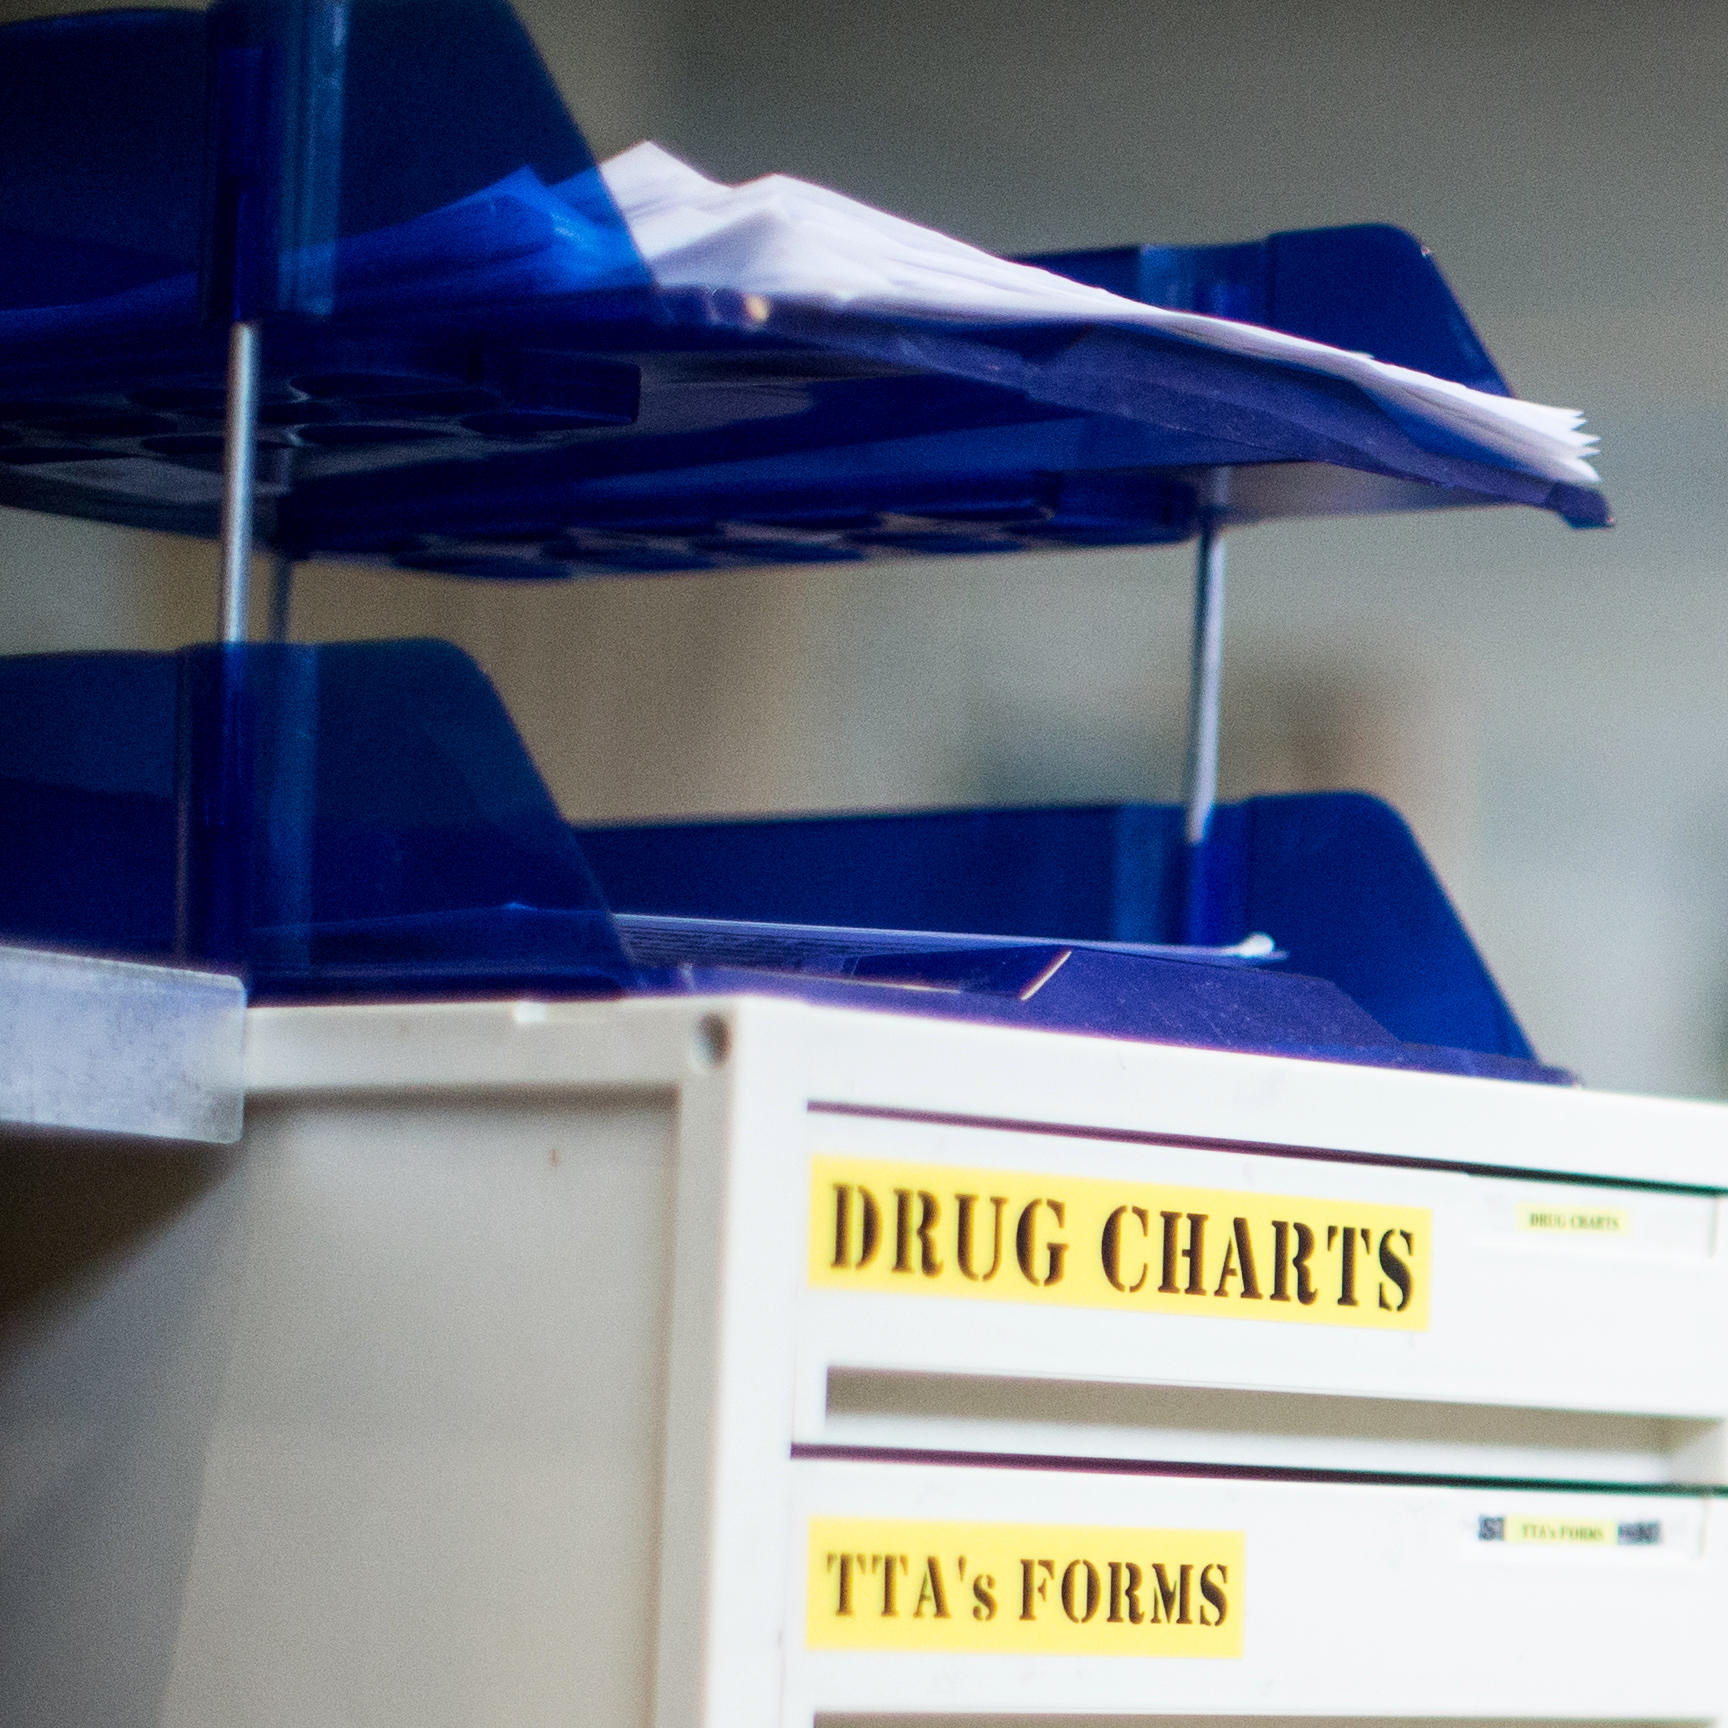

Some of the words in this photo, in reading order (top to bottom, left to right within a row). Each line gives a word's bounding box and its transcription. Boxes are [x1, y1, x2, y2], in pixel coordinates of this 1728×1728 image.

[831, 1184, 1066, 1287] DRUG
[1099, 1205, 1414, 1314] CHARTS
[827, 1552, 997, 1620] TTA's
[1019, 1557, 1228, 1628] FORMS
